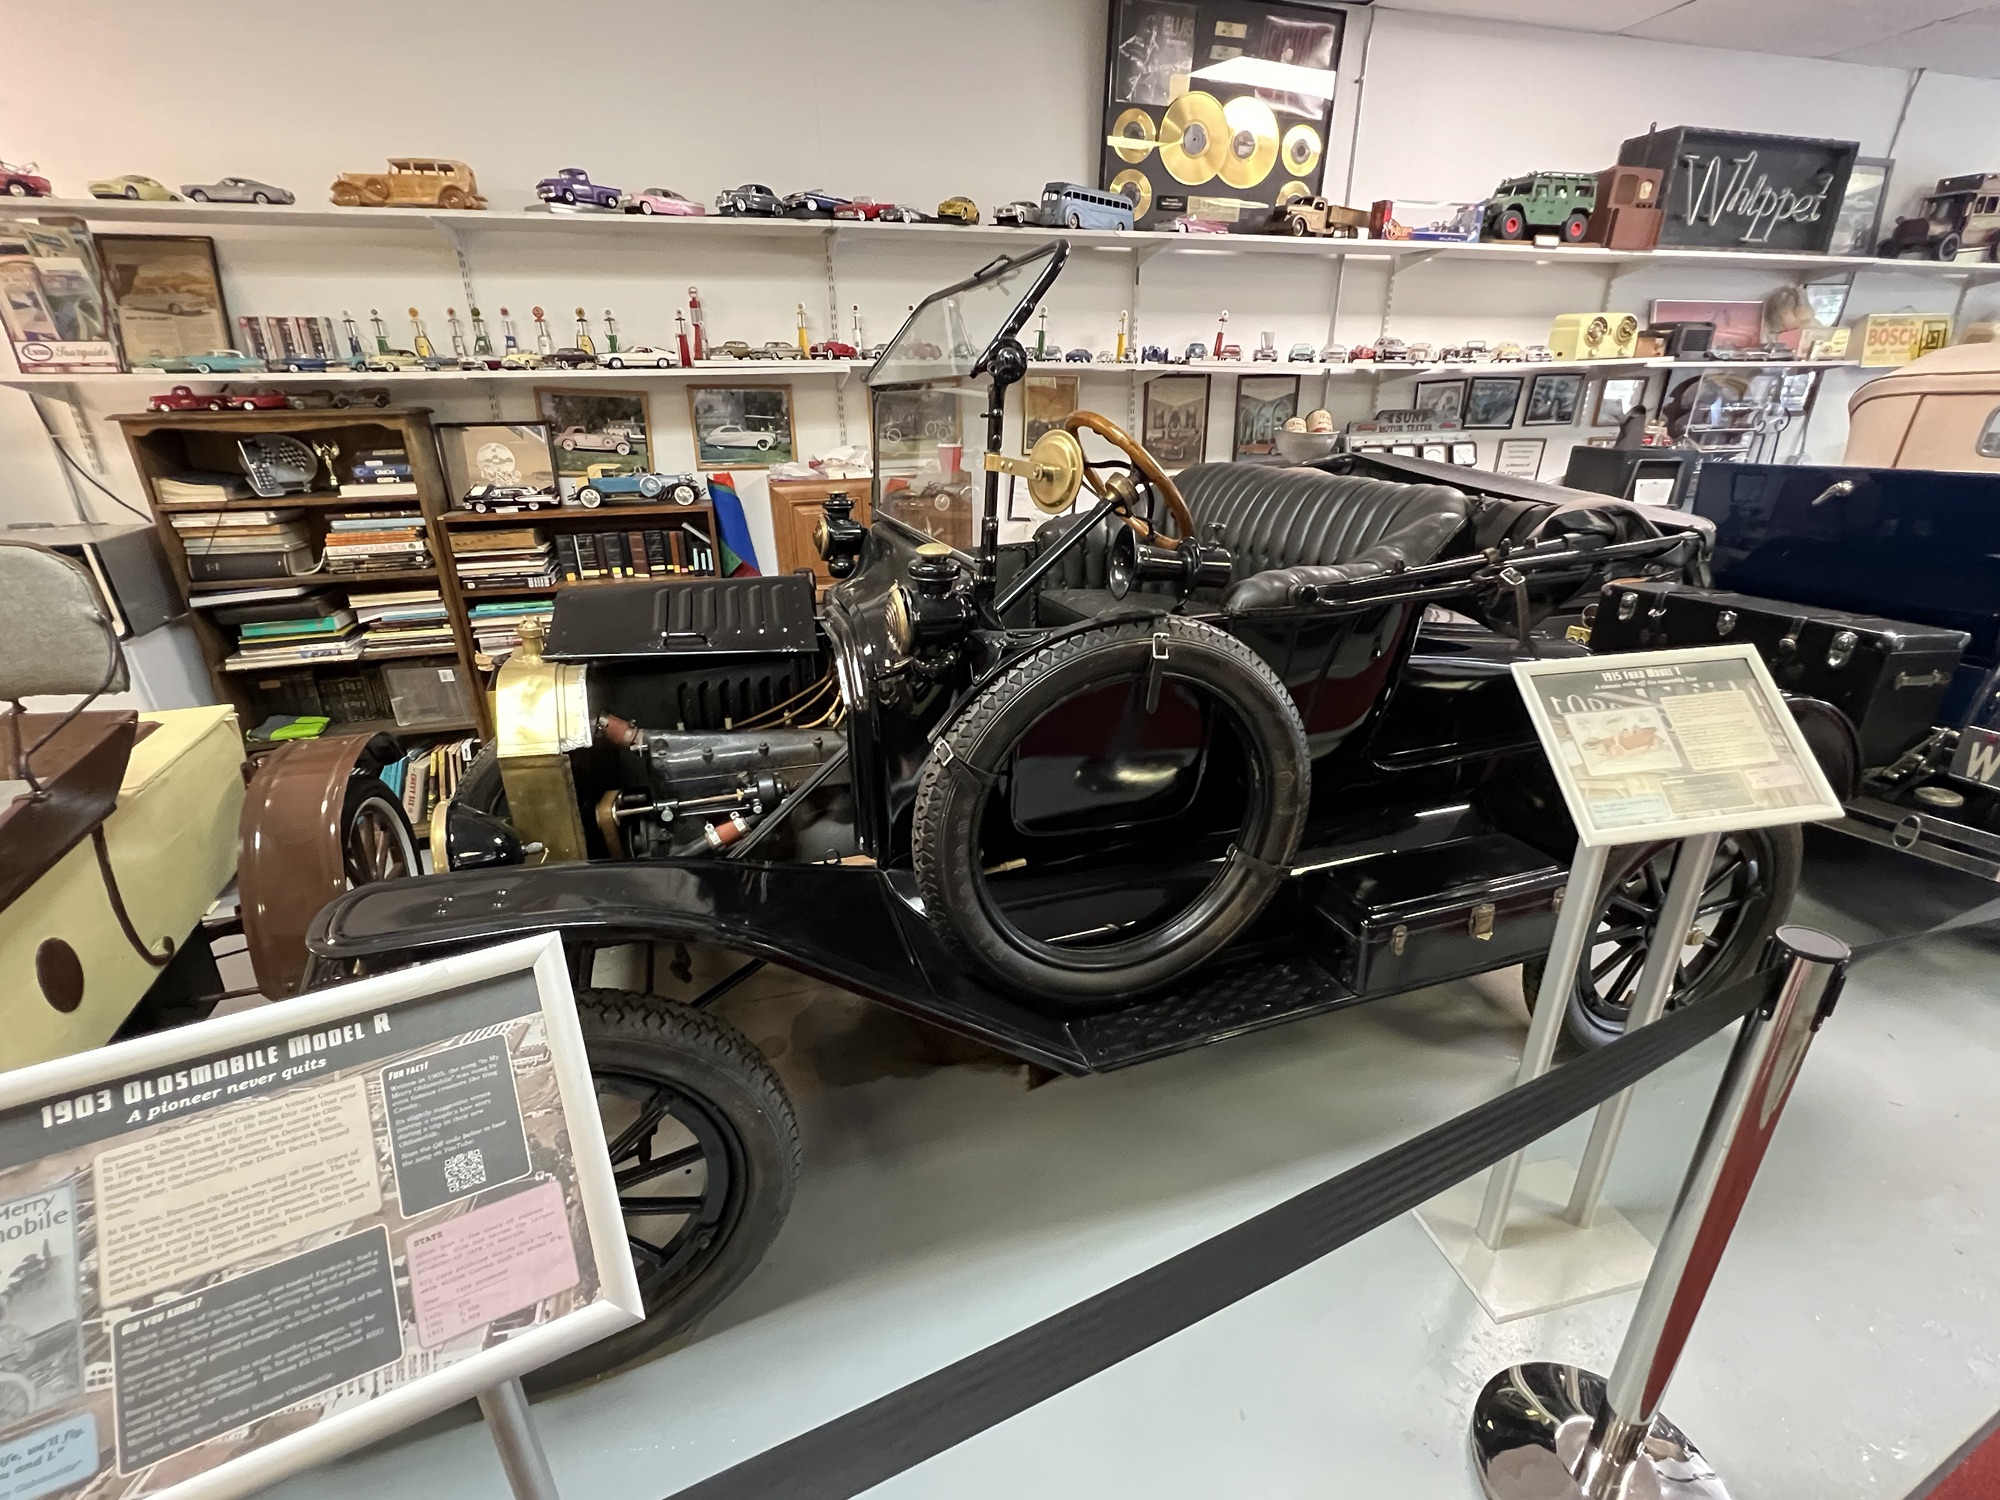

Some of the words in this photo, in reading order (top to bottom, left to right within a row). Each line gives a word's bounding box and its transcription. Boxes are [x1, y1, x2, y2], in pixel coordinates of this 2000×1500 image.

[1867, 328, 1920, 347] BOSCH
[1965, 741, 2000, 784] W
[41, 1089, 113, 1128] 1903
[373, 1012, 392, 1035] R
[127, 1109, 142, 1124] A
[146, 1090, 222, 1121] pioneer
[227, 1072, 277, 1094] never
[281, 1057, 328, 1082] quits
[0, 1210, 69, 1243] obile
